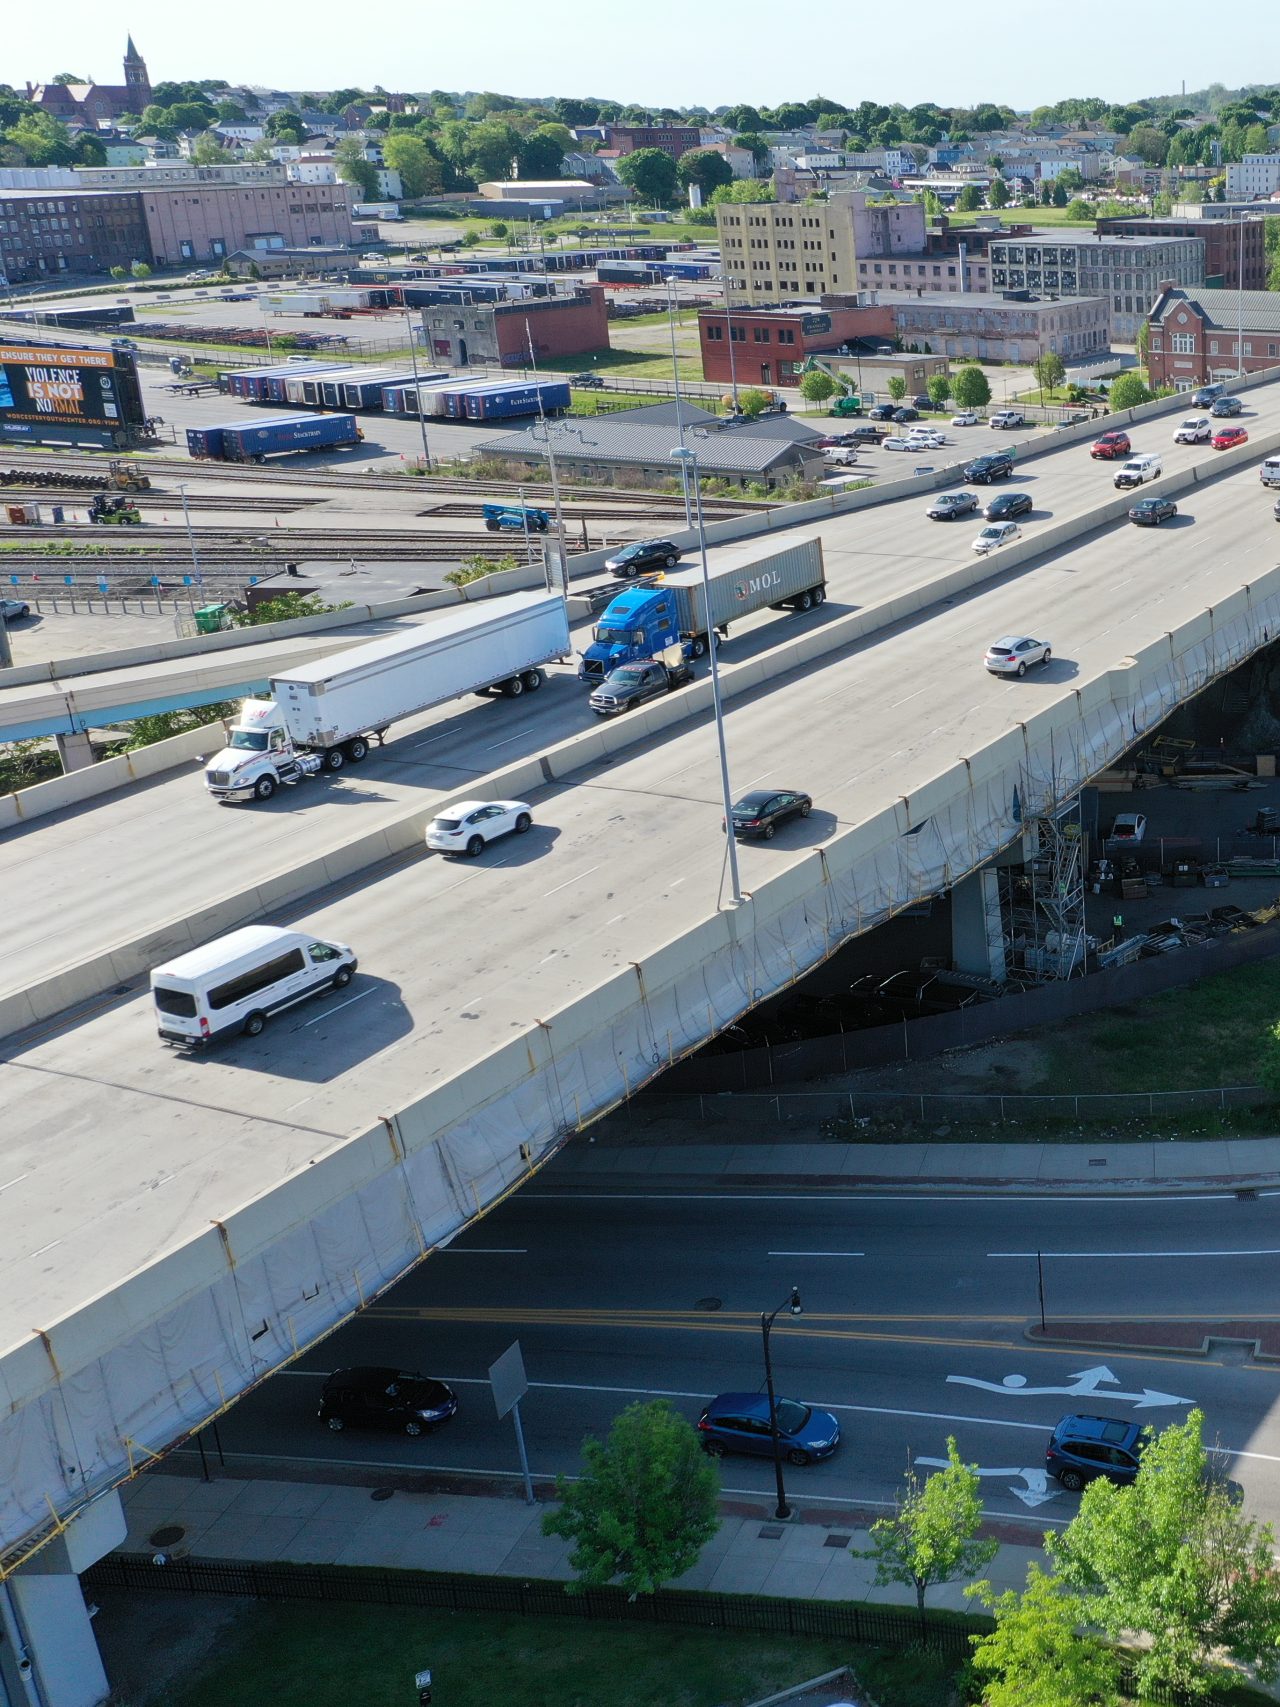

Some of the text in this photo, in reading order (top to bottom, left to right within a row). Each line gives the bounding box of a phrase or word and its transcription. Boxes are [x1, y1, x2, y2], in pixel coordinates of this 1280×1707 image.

[1, 351, 108, 365] ENSURE THEY GET THERE
[25, 366, 82, 385] VIOLENCE
[27, 383, 82, 399] IS NOT
[749, 570, 781, 594] MOL
